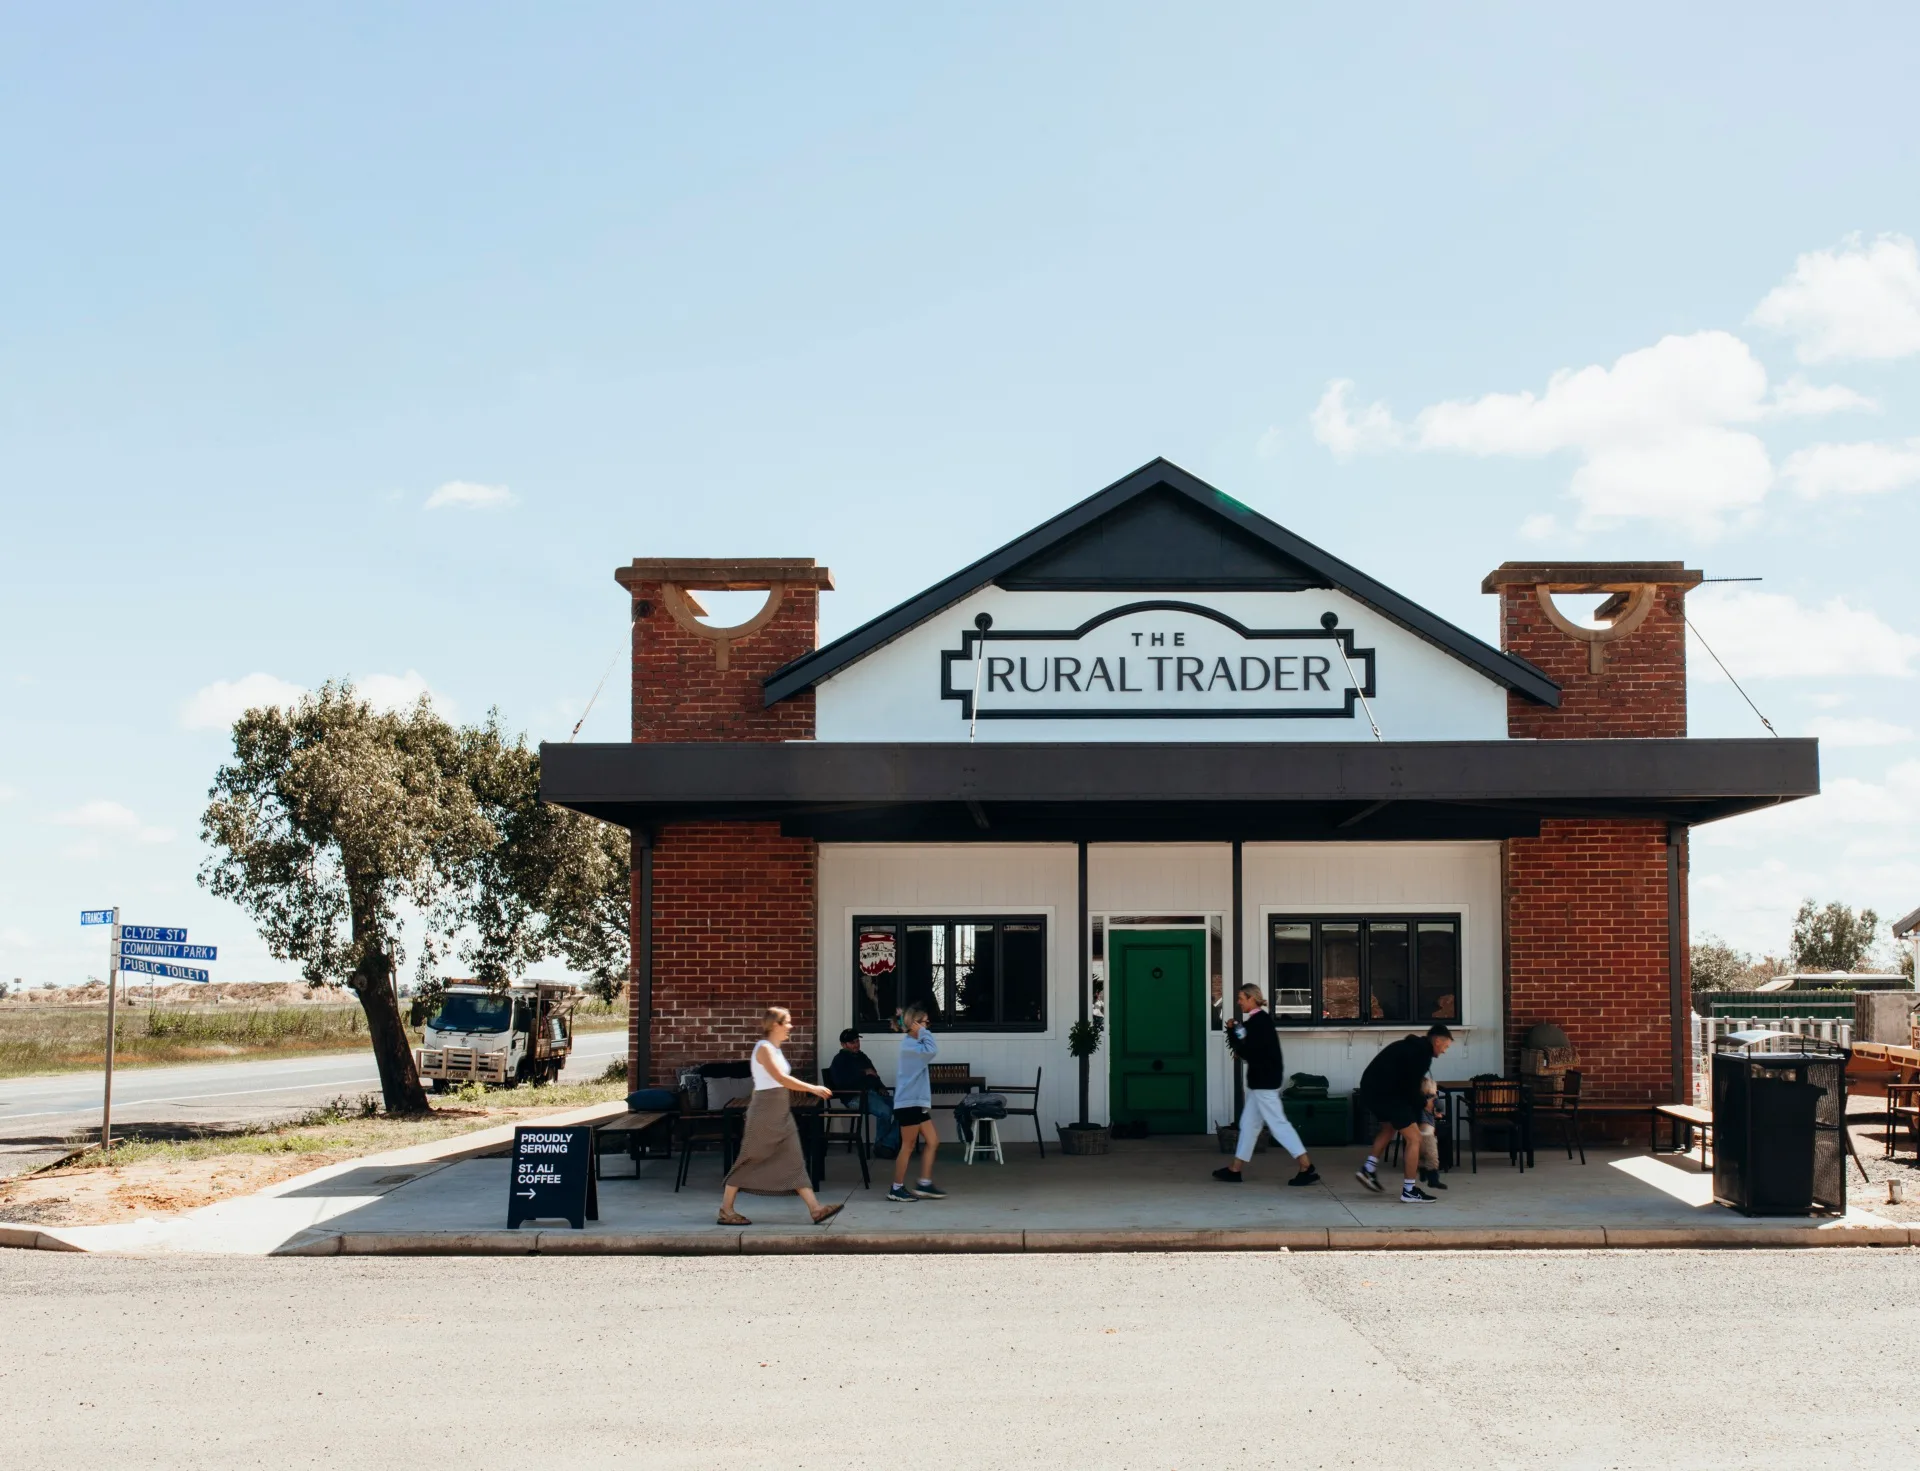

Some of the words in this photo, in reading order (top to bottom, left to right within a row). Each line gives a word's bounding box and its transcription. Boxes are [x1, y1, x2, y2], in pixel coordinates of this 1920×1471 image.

[1131, 632, 1186, 647] THE
[105, 911, 113, 923] ST
[124, 926, 161, 940] CLYDE
[165, 929, 180, 941] ST
[124, 942, 179, 957] COMMUNITY
[183, 946, 208, 958] PARK
[123, 958, 161, 974] PUBLIC
[165, 965, 201, 980] TOILET
[521, 1133, 573, 1143] PROUDLY
[520, 1144, 568, 1154] SERVING
[518, 1164, 534, 1173] ST.
[517, 1174, 562, 1184] COFFEE
